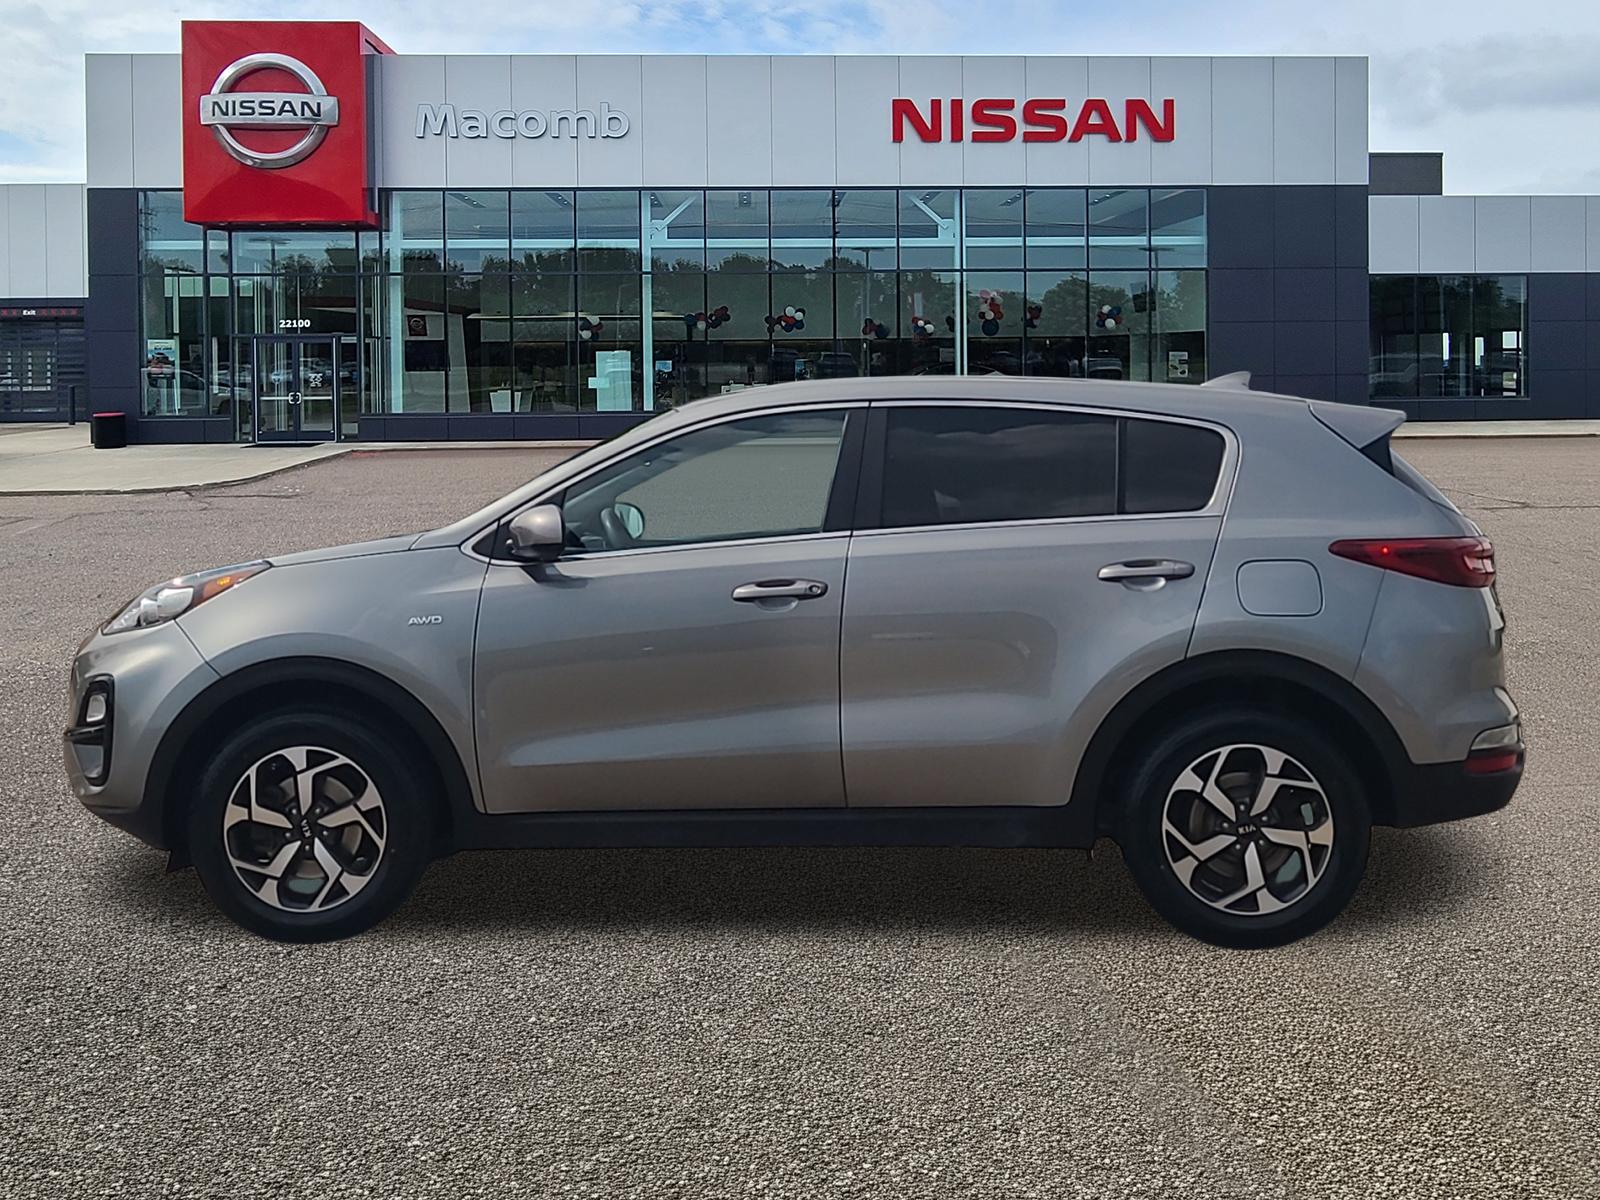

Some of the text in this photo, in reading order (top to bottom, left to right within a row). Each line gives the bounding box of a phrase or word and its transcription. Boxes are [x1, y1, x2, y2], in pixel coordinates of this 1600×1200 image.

[212, 100, 322, 118] NISSAN
[415, 102, 630, 138] Macomb
[892, 98, 1176, 143] NISSAN
[279, 319, 311, 328] 22100
[408, 615, 443, 626] AWD
